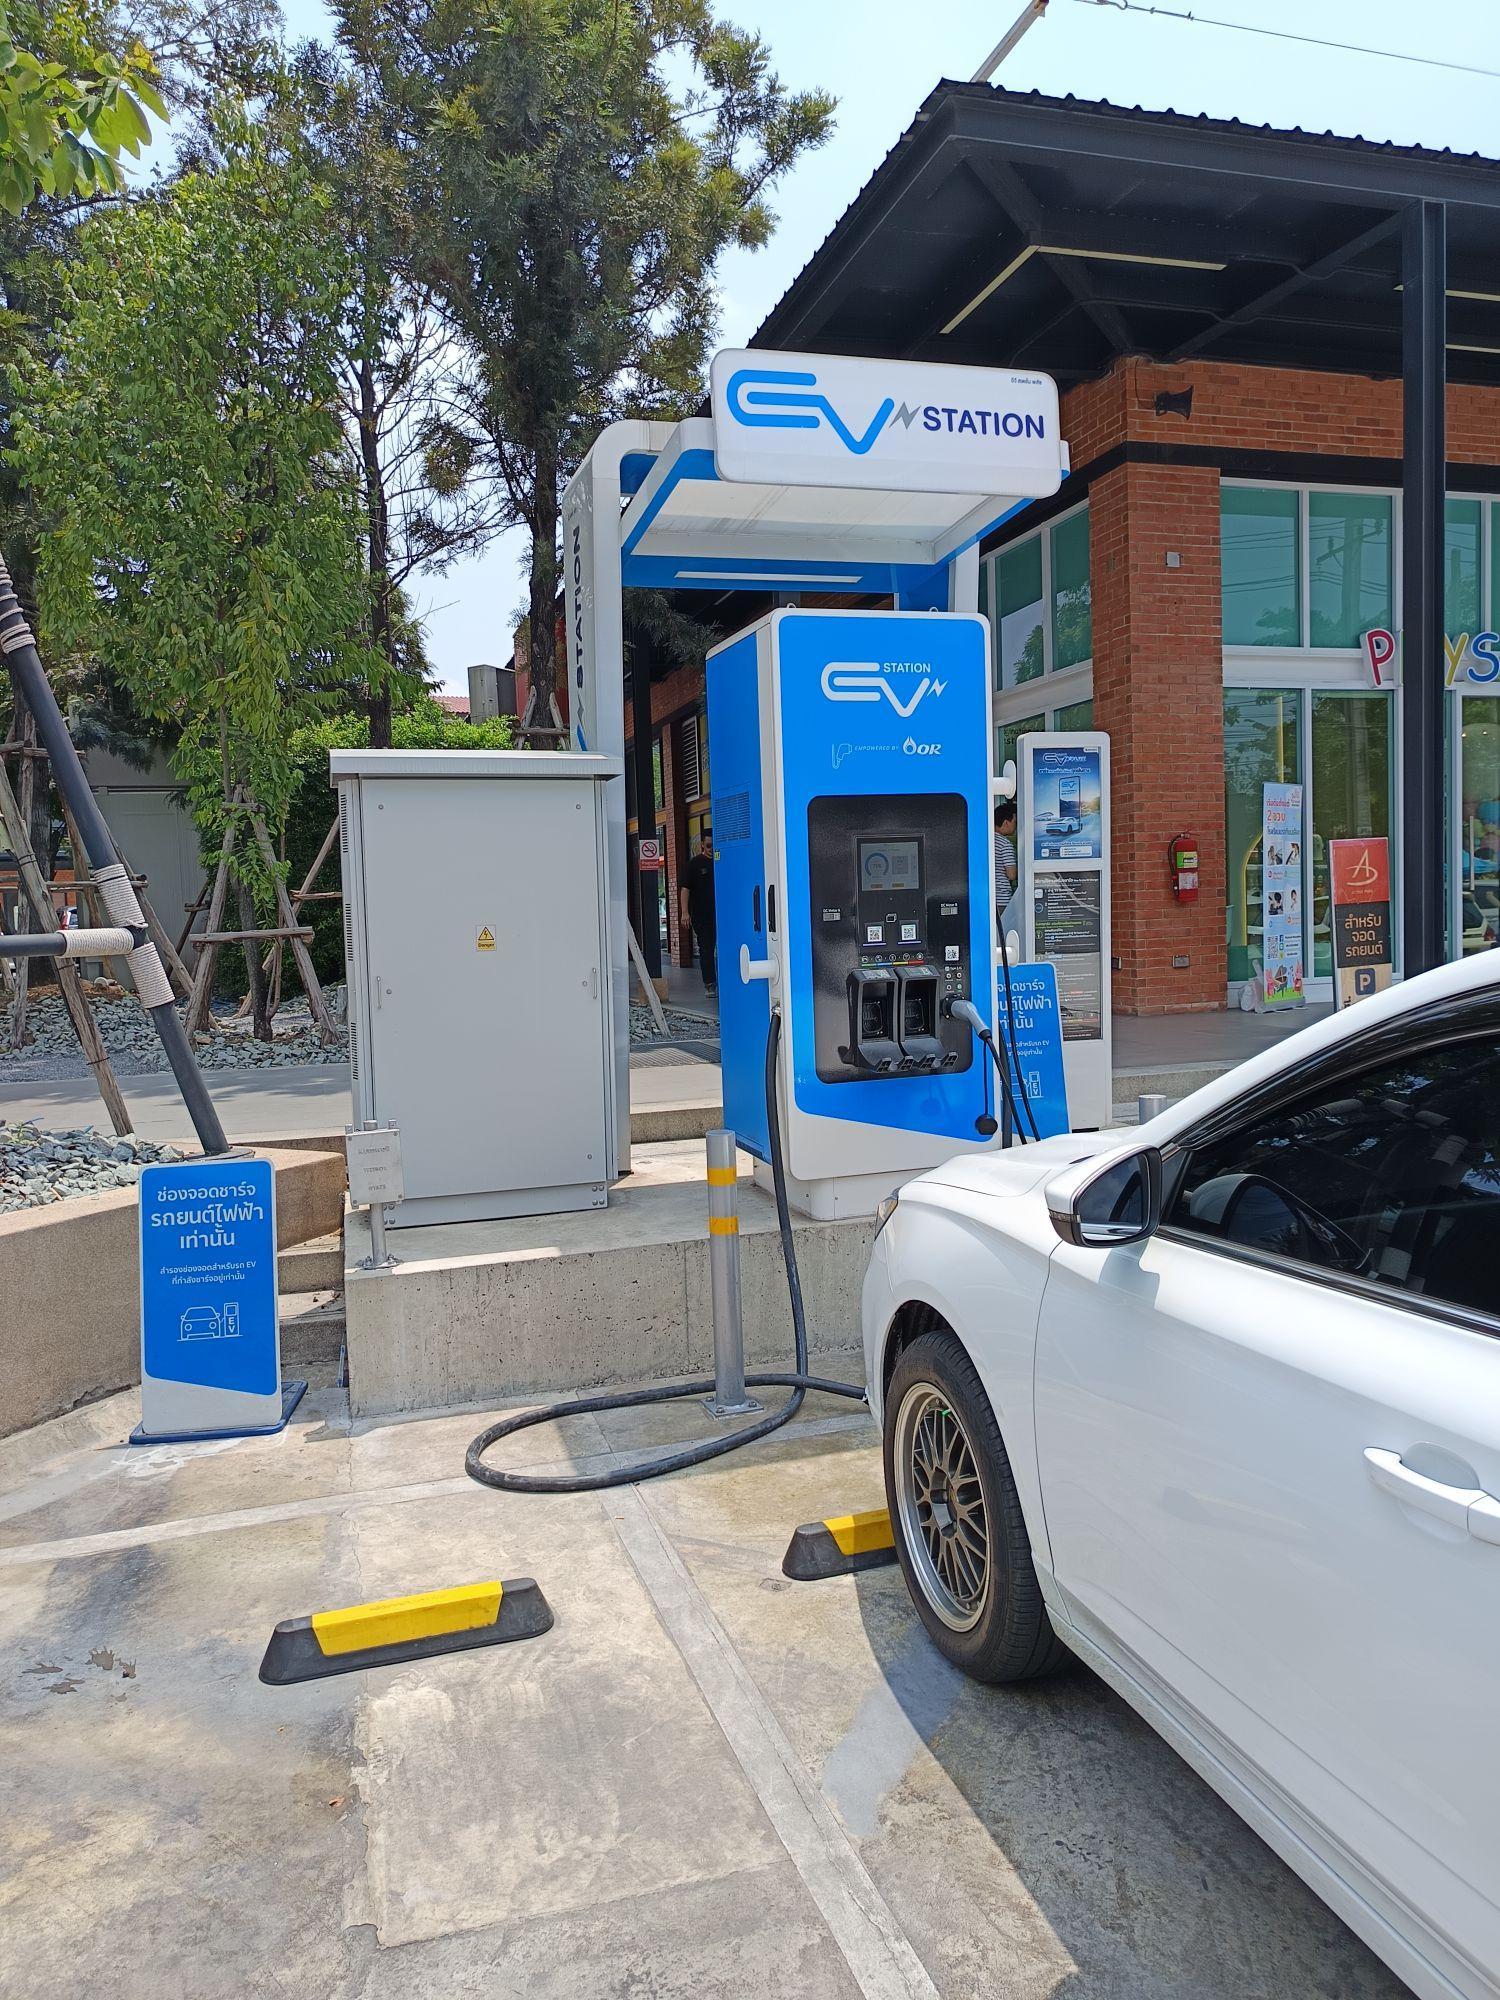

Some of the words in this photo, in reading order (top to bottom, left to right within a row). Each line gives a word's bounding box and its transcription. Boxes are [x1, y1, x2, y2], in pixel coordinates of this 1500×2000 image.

[727, 369, 895, 454] EV
[923, 406, 1045, 438] STATION
[573, 525, 584, 689] STATION
[883, 662, 931, 673] STATION
[820, 662, 931, 718] EV
[916, 743, 942, 755] OR
[1344, 913, 1382, 929] สำหรับ
[1351, 930, 1376, 942] จอด
[1345, 941, 1383, 957] รถยนต์
[1359, 974, 1371, 991] P
[157, 1181, 256, 1202] ช่องจอดชาร์จ
[151, 1201, 264, 1227] รถยนต์ไฟฟ้า
[180, 1223, 235, 1249] เท่านั้น
